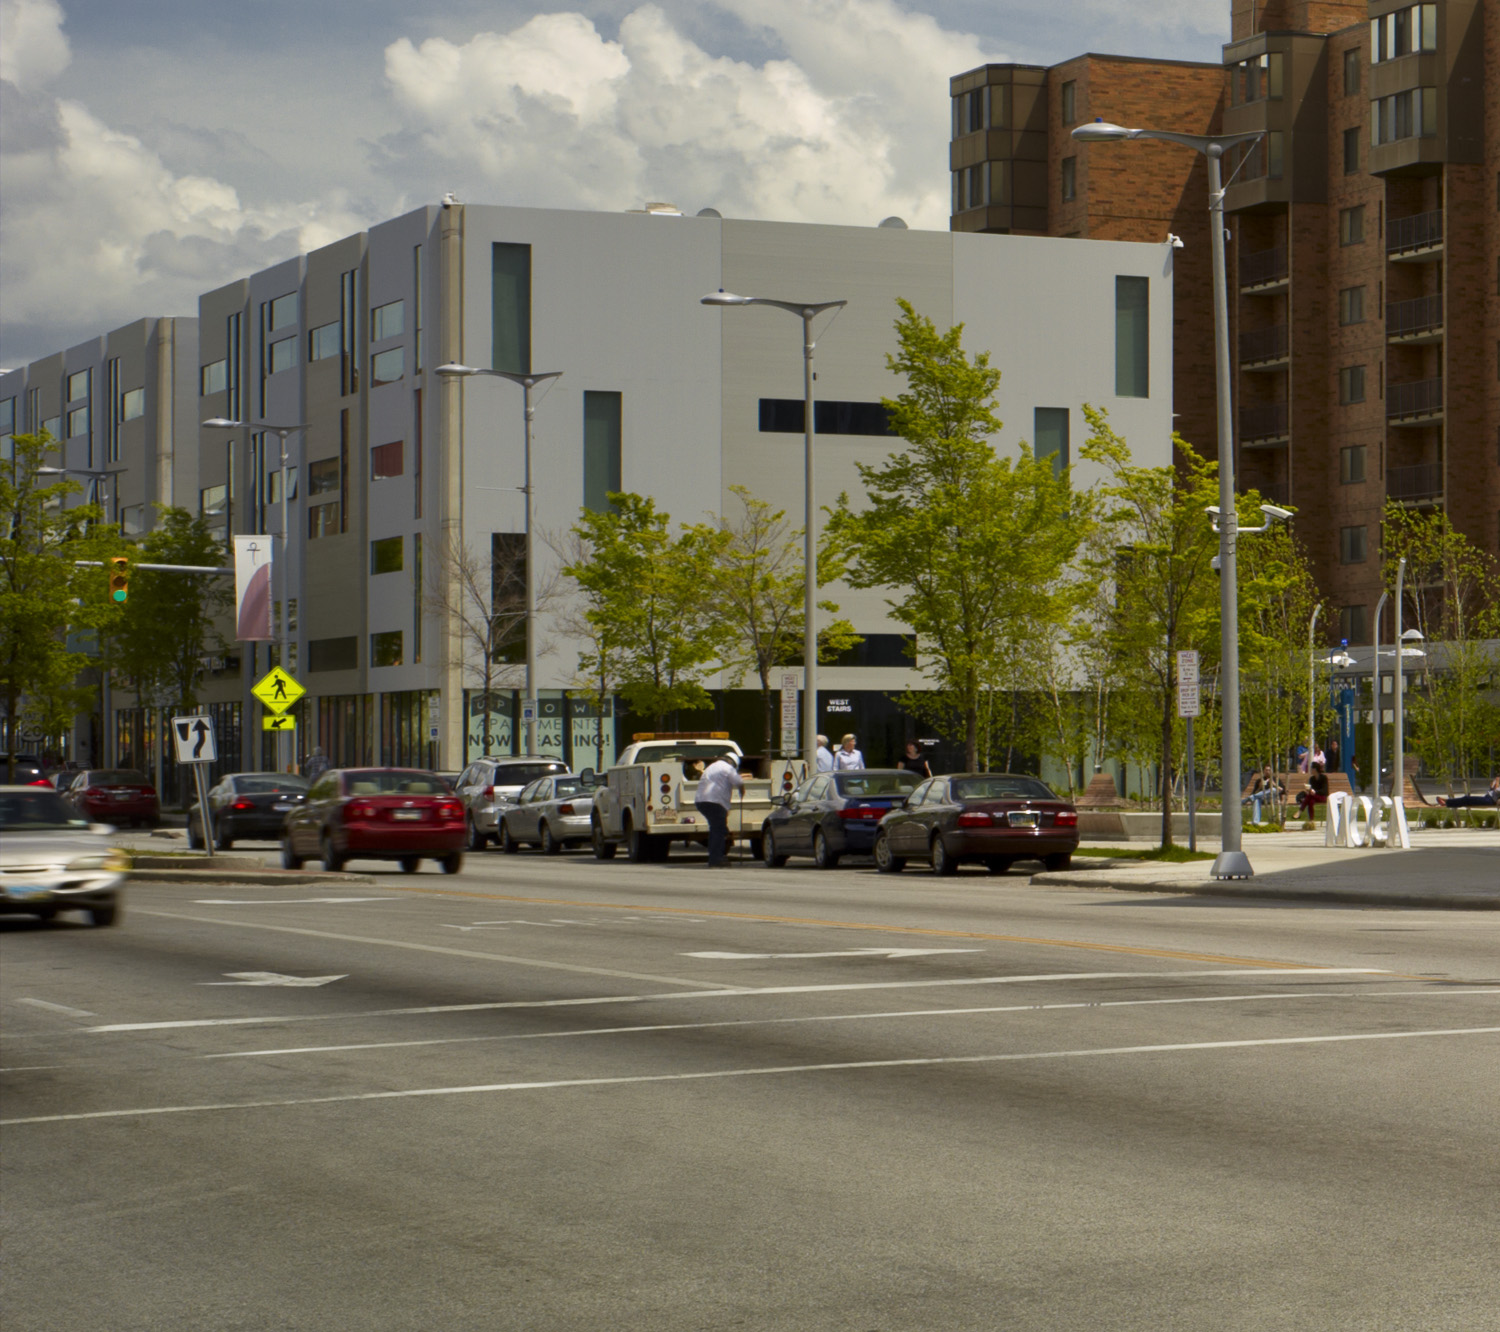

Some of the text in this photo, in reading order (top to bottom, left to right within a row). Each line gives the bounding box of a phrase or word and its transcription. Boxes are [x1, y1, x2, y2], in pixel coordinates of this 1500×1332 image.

[826, 705, 852, 713] STAIRS
[476, 718, 600, 731] APARMENTS
[469, 734, 511, 748] NOW
[524, 733, 610, 748] LASING!
